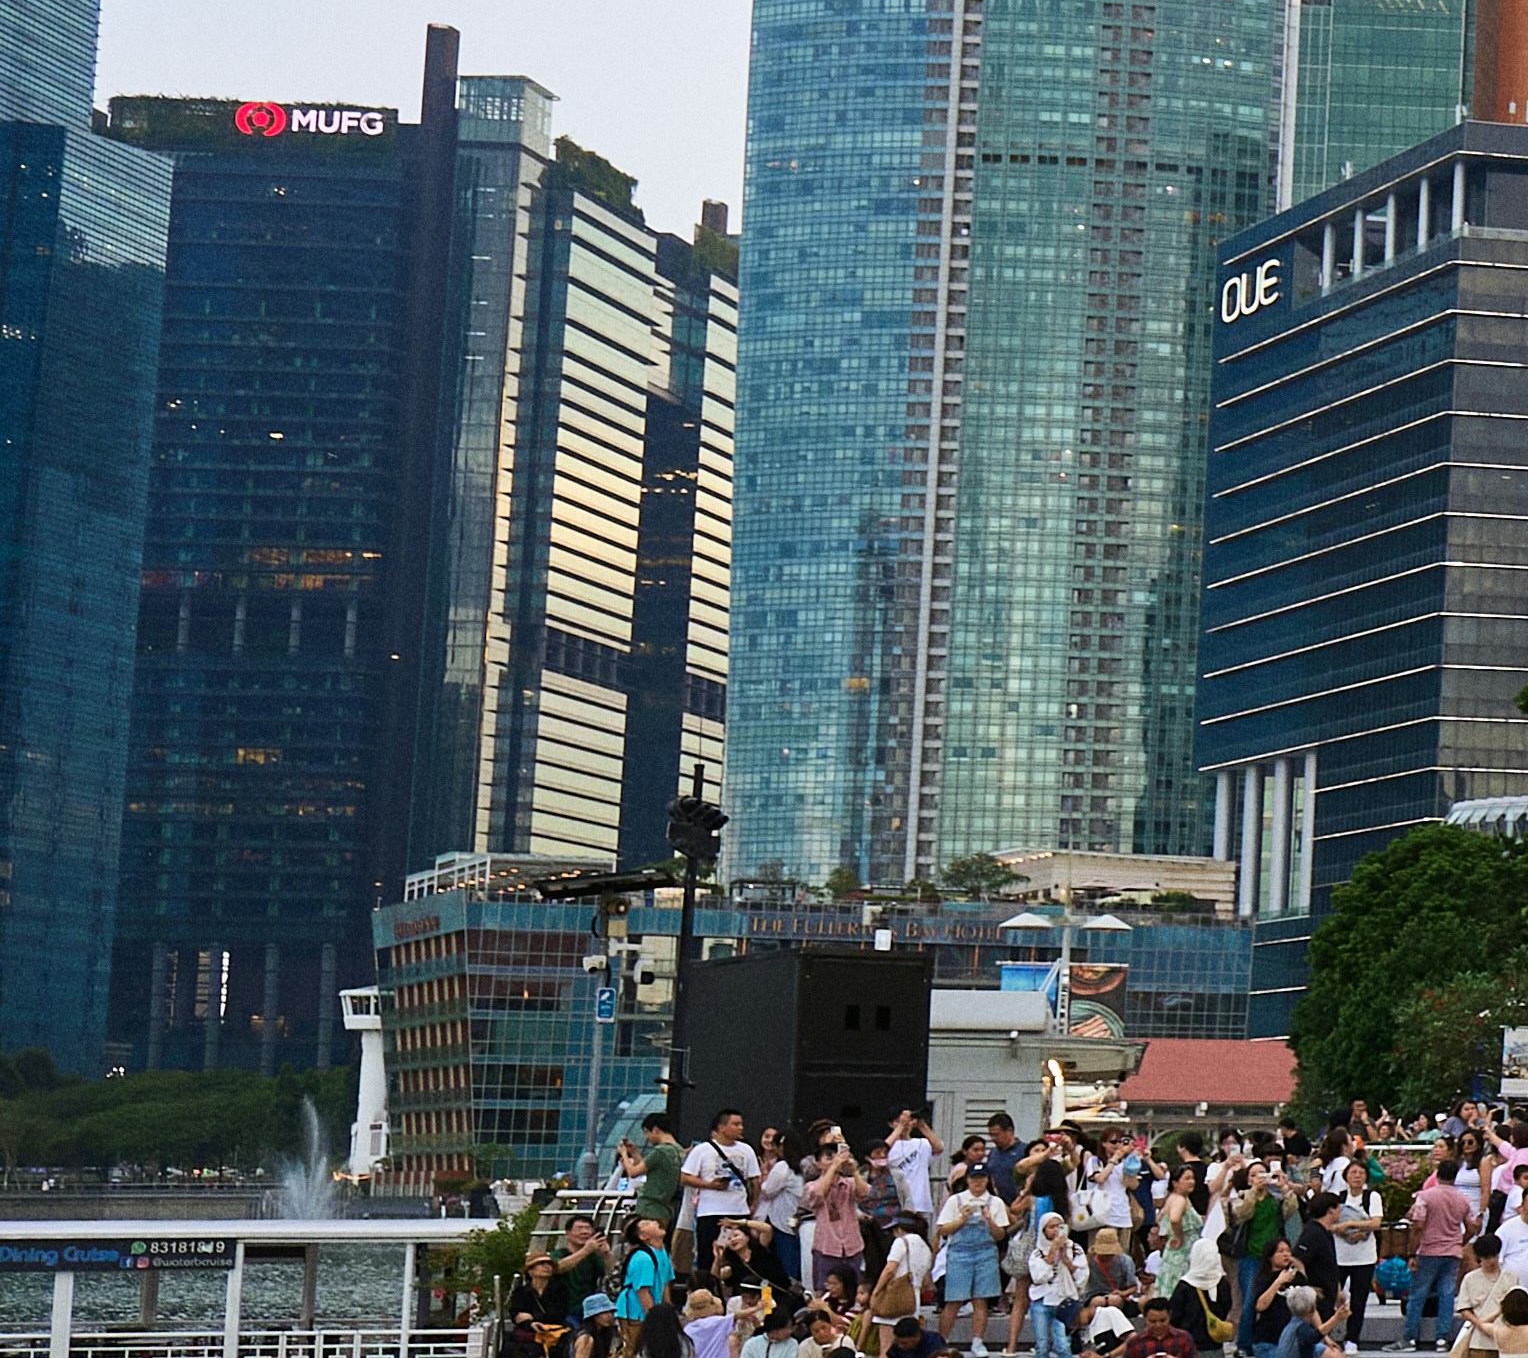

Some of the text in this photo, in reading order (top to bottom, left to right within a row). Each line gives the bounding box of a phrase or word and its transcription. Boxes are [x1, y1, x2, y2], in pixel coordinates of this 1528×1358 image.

[291, 109, 384, 136] MUFG
[1221, 258, 1281, 324] OUE
[793, 918, 897, 938] FULLER
[149, 1241, 226, 1254] 8318189
